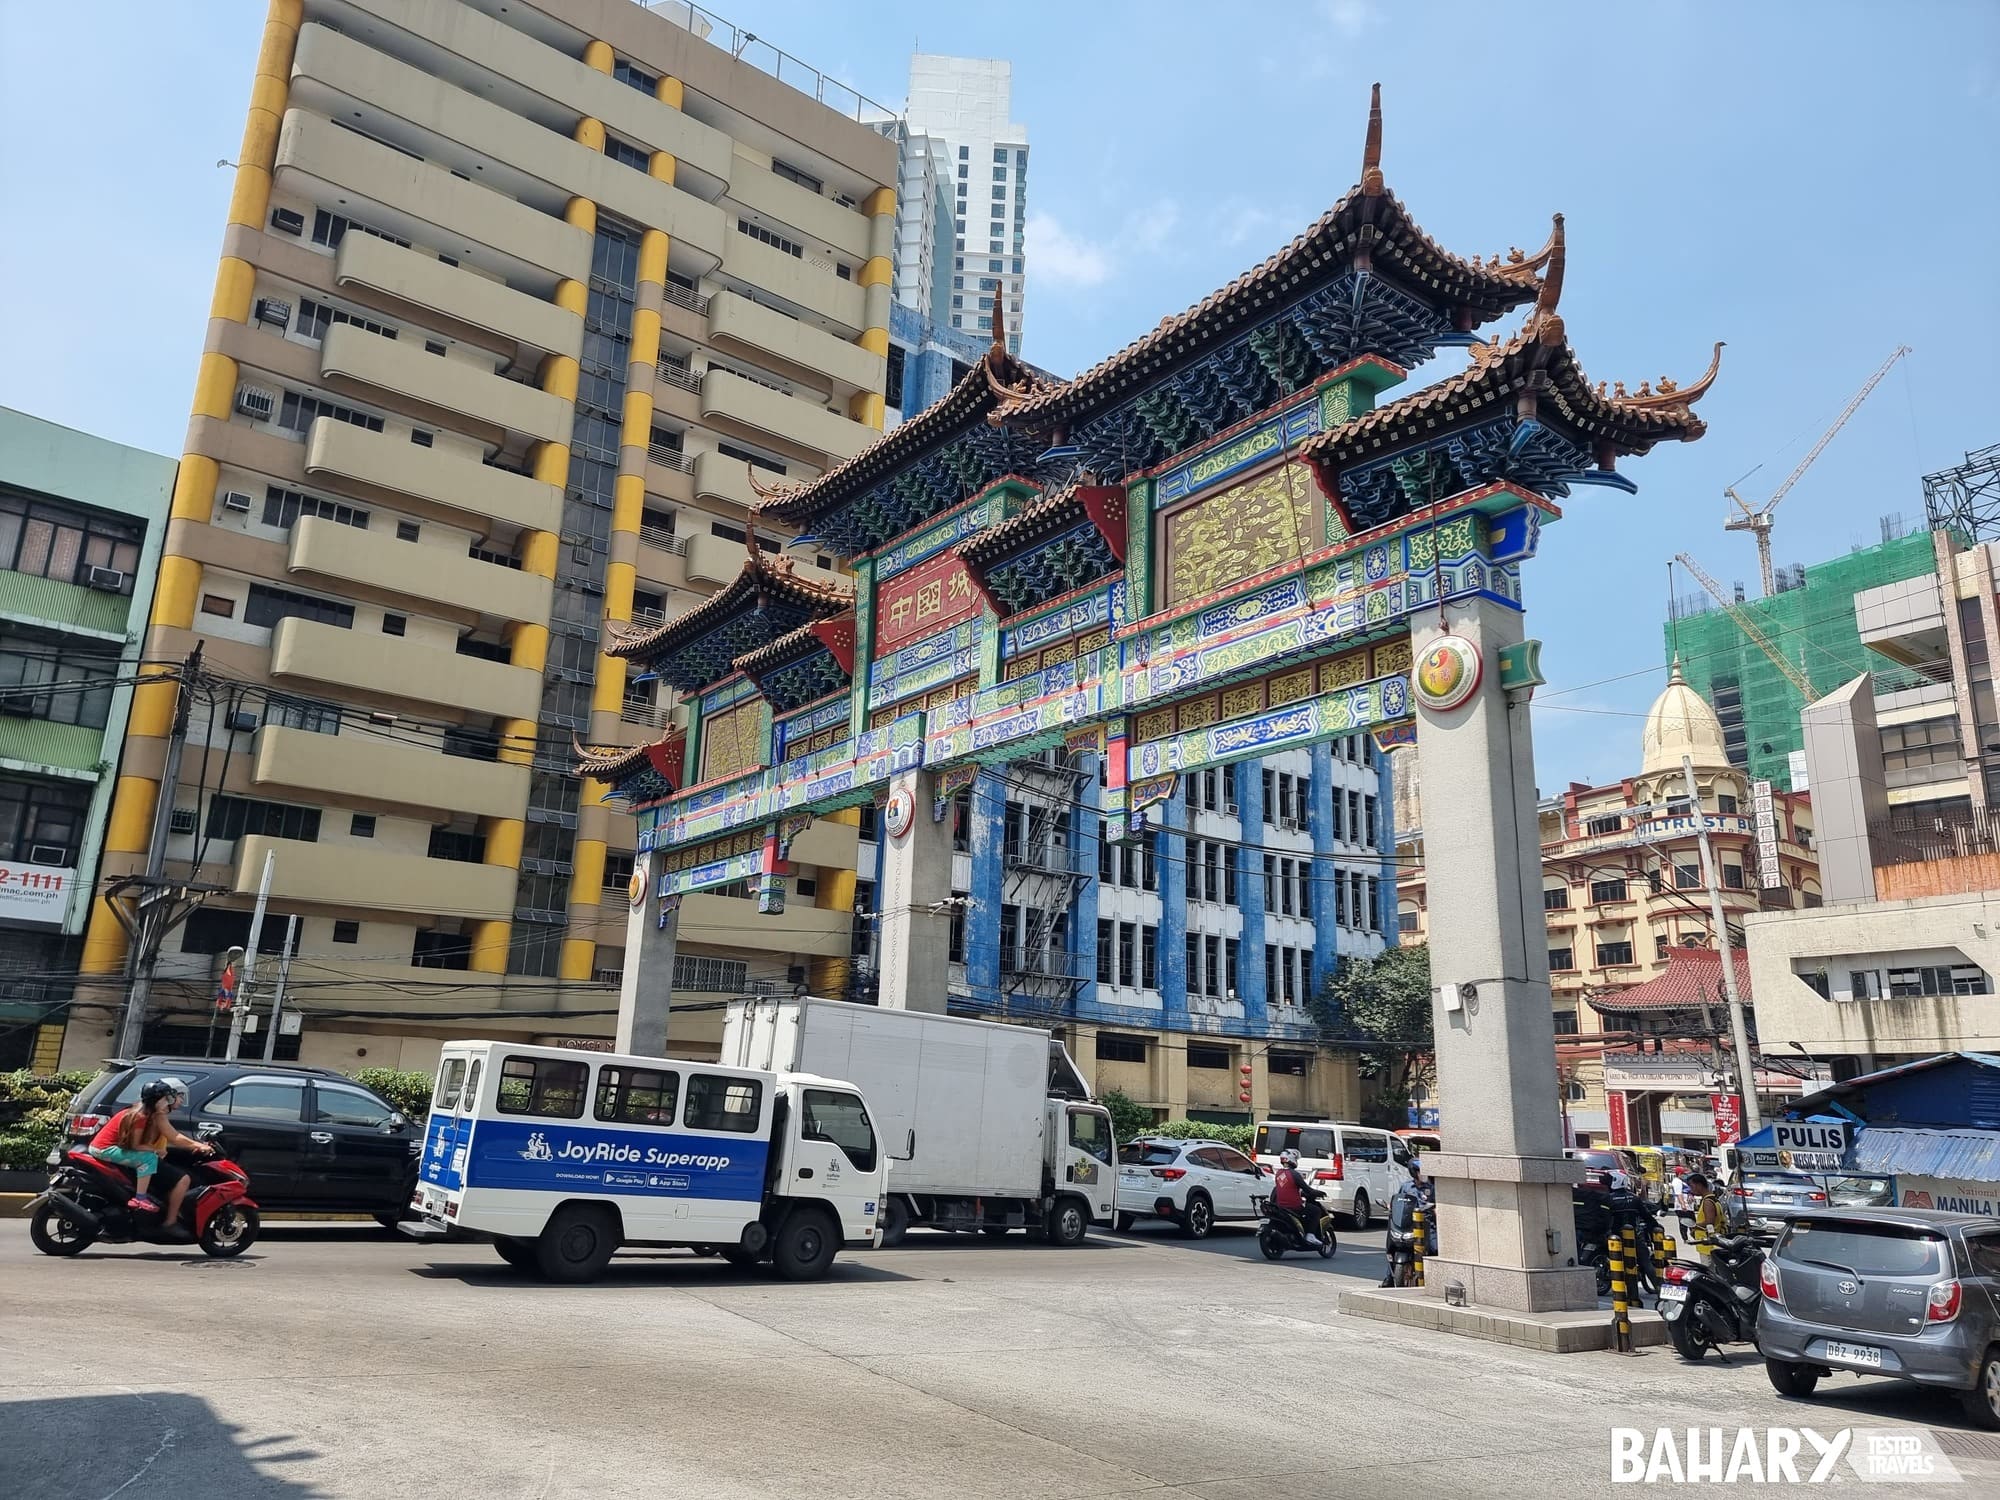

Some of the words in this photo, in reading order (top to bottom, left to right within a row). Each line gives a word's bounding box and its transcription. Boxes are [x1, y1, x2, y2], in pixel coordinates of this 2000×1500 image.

[889, 568, 971, 630] 中國城
[1638, 815, 1727, 837] HILTRUST
[1777, 1127, 1843, 1149] PULIS
[558, 1140, 641, 1163] JoyRide
[644, 1148, 730, 1172] Superapp
[1815, 1153, 1838, 1171] POLICE
[616, 1177, 633, 1185] Google
[1957, 1185, 1998, 1198] National
[1937, 1195, 1993, 1216] MANILA
[1828, 1344, 1847, 1358] DBZ
[1853, 1348, 1880, 1363] 9938
